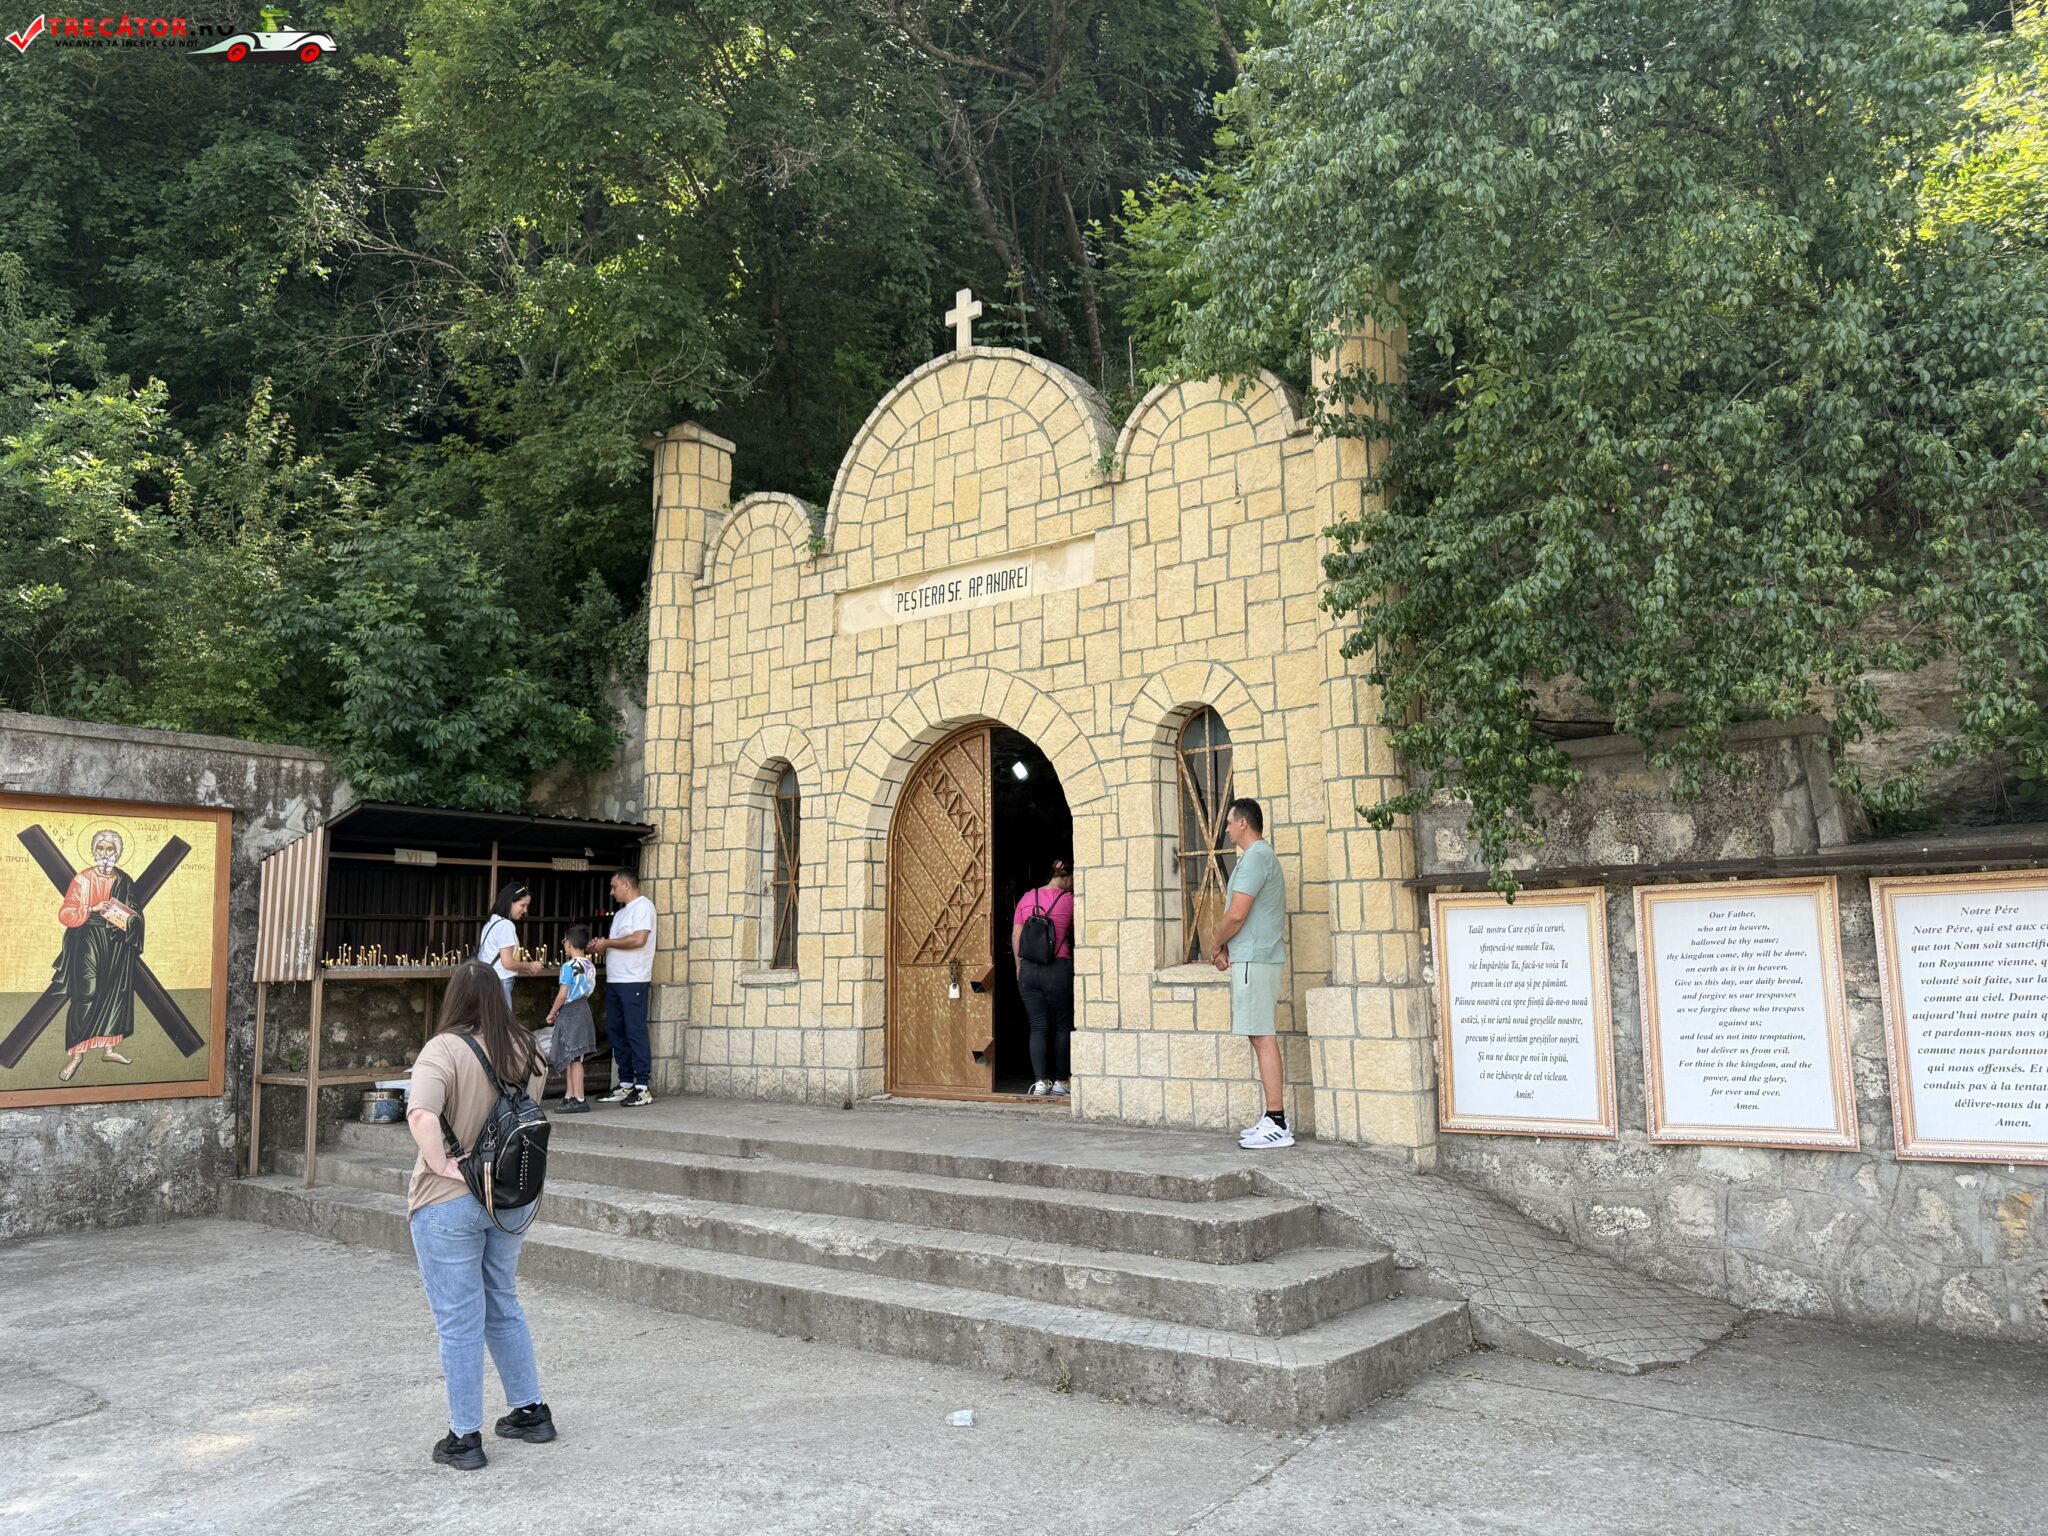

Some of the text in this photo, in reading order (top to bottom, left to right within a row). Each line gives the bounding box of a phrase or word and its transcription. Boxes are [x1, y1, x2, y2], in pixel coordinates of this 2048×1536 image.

[948, 580, 962, 602] SF.
[968, 576, 983, 598] AP.
[1960, 907, 1991, 916] Notre
[1486, 926, 1507, 934] nostru
[1507, 924, 1523, 934] Care
[1697, 925, 1714, 933] who
[1913, 926, 1943, 935] Notre
[1976, 923, 1995, 935] qui
[1997, 924, 2013, 932] est
[1516, 942, 1539, 951] numele
[1690, 938, 1726, 946] hallowed
[1727, 937, 1737, 945] be
[1738, 937, 1752, 946] thy
[1911, 945, 1931, 954] que
[1954, 941, 1980, 950] Nom
[1983, 940, 2003, 950] soit
[1666, 953, 1679, 962] thy
[1680, 952, 1714, 961] kingdom
[1741, 950, 1754, 960] thy
[1756, 950, 1771, 958] will
[1561, 959, 1569, 969] Ta
[1998, 957, 2038, 967] vienne,
[1697, 965, 1718, 973] earth
[1730, 964, 1737, 972] it
[1747, 964, 1756, 972] in
[1470, 981, 1494, 990] precum
[1532, 981, 1541, 990] pe
[1674, 979, 1692, 987] Give
[1705, 978, 1719, 986] this
[1721, 978, 1737, 987] day,
[1755, 977, 1776, 986] daily
[1777, 977, 1803, 985] bread,
[1920, 976, 1959, 985] volonté
[1962, 976, 1982, 985] soit
[1983, 975, 2012, 987] faite,
[2037, 974, 2048, 984] la
[1682, 992, 1698, 1000] and
[1698, 992, 1727, 1002] forgive
[1924, 995, 1962, 1003] comme
[1982, 992, 2005, 1002] ciel.
[1699, 1005, 1728, 1015] forgive
[1729, 1005, 1751, 1013] those
[1771, 1006, 1805, 1014] trespass
[1912, 1010, 1978, 1022] aujourd'hui
[2012, 1010, 2038, 1022] pain
[1718, 1019, 1748, 1028] against
[1465, 1033, 1507, 1045] precum noi
[1759, 1032, 1806, 1042] temptation,
[1934, 1028, 2012, 1040] pardonn-nous
[1696, 1046, 1710, 1054] but
[1710, 1046, 1738, 1054] deliver
[1750, 1046, 1771, 1056] from
[1773, 1046, 1790, 1054] evil.
[1504, 1052, 1520, 1062] duce
[1520, 1055, 1529, 1064] pe
[1529, 1053, 1541, 1062] noi
[1679, 1060, 1813, 1070] For thine is the kingdom, and the
[1927, 1063, 1945, 1074] qui
[1977, 1063, 2025, 1075] offensés.
[2030, 1064, 2043, 1073] Et
[1524, 1071, 1533, 1081] de
[1533, 1071, 1543, 1081] cel
[1544, 1072, 1568, 1082] viclean.
[1731, 1074, 1747, 1082] and
[1748, 1074, 1762, 1082] the
[1923, 1081, 2011, 1093] conduis pas à la
[1514, 1090, 1535, 1099] Amin!
[1710, 1088, 1724, 1097] for
[1734, 1102, 1760, 1110] Amen.
[1954, 1098, 2024, 1109] délivre-nous
[2026, 1100, 2041, 1110] du
[1995, 1118, 2032, 1128] Amen.
